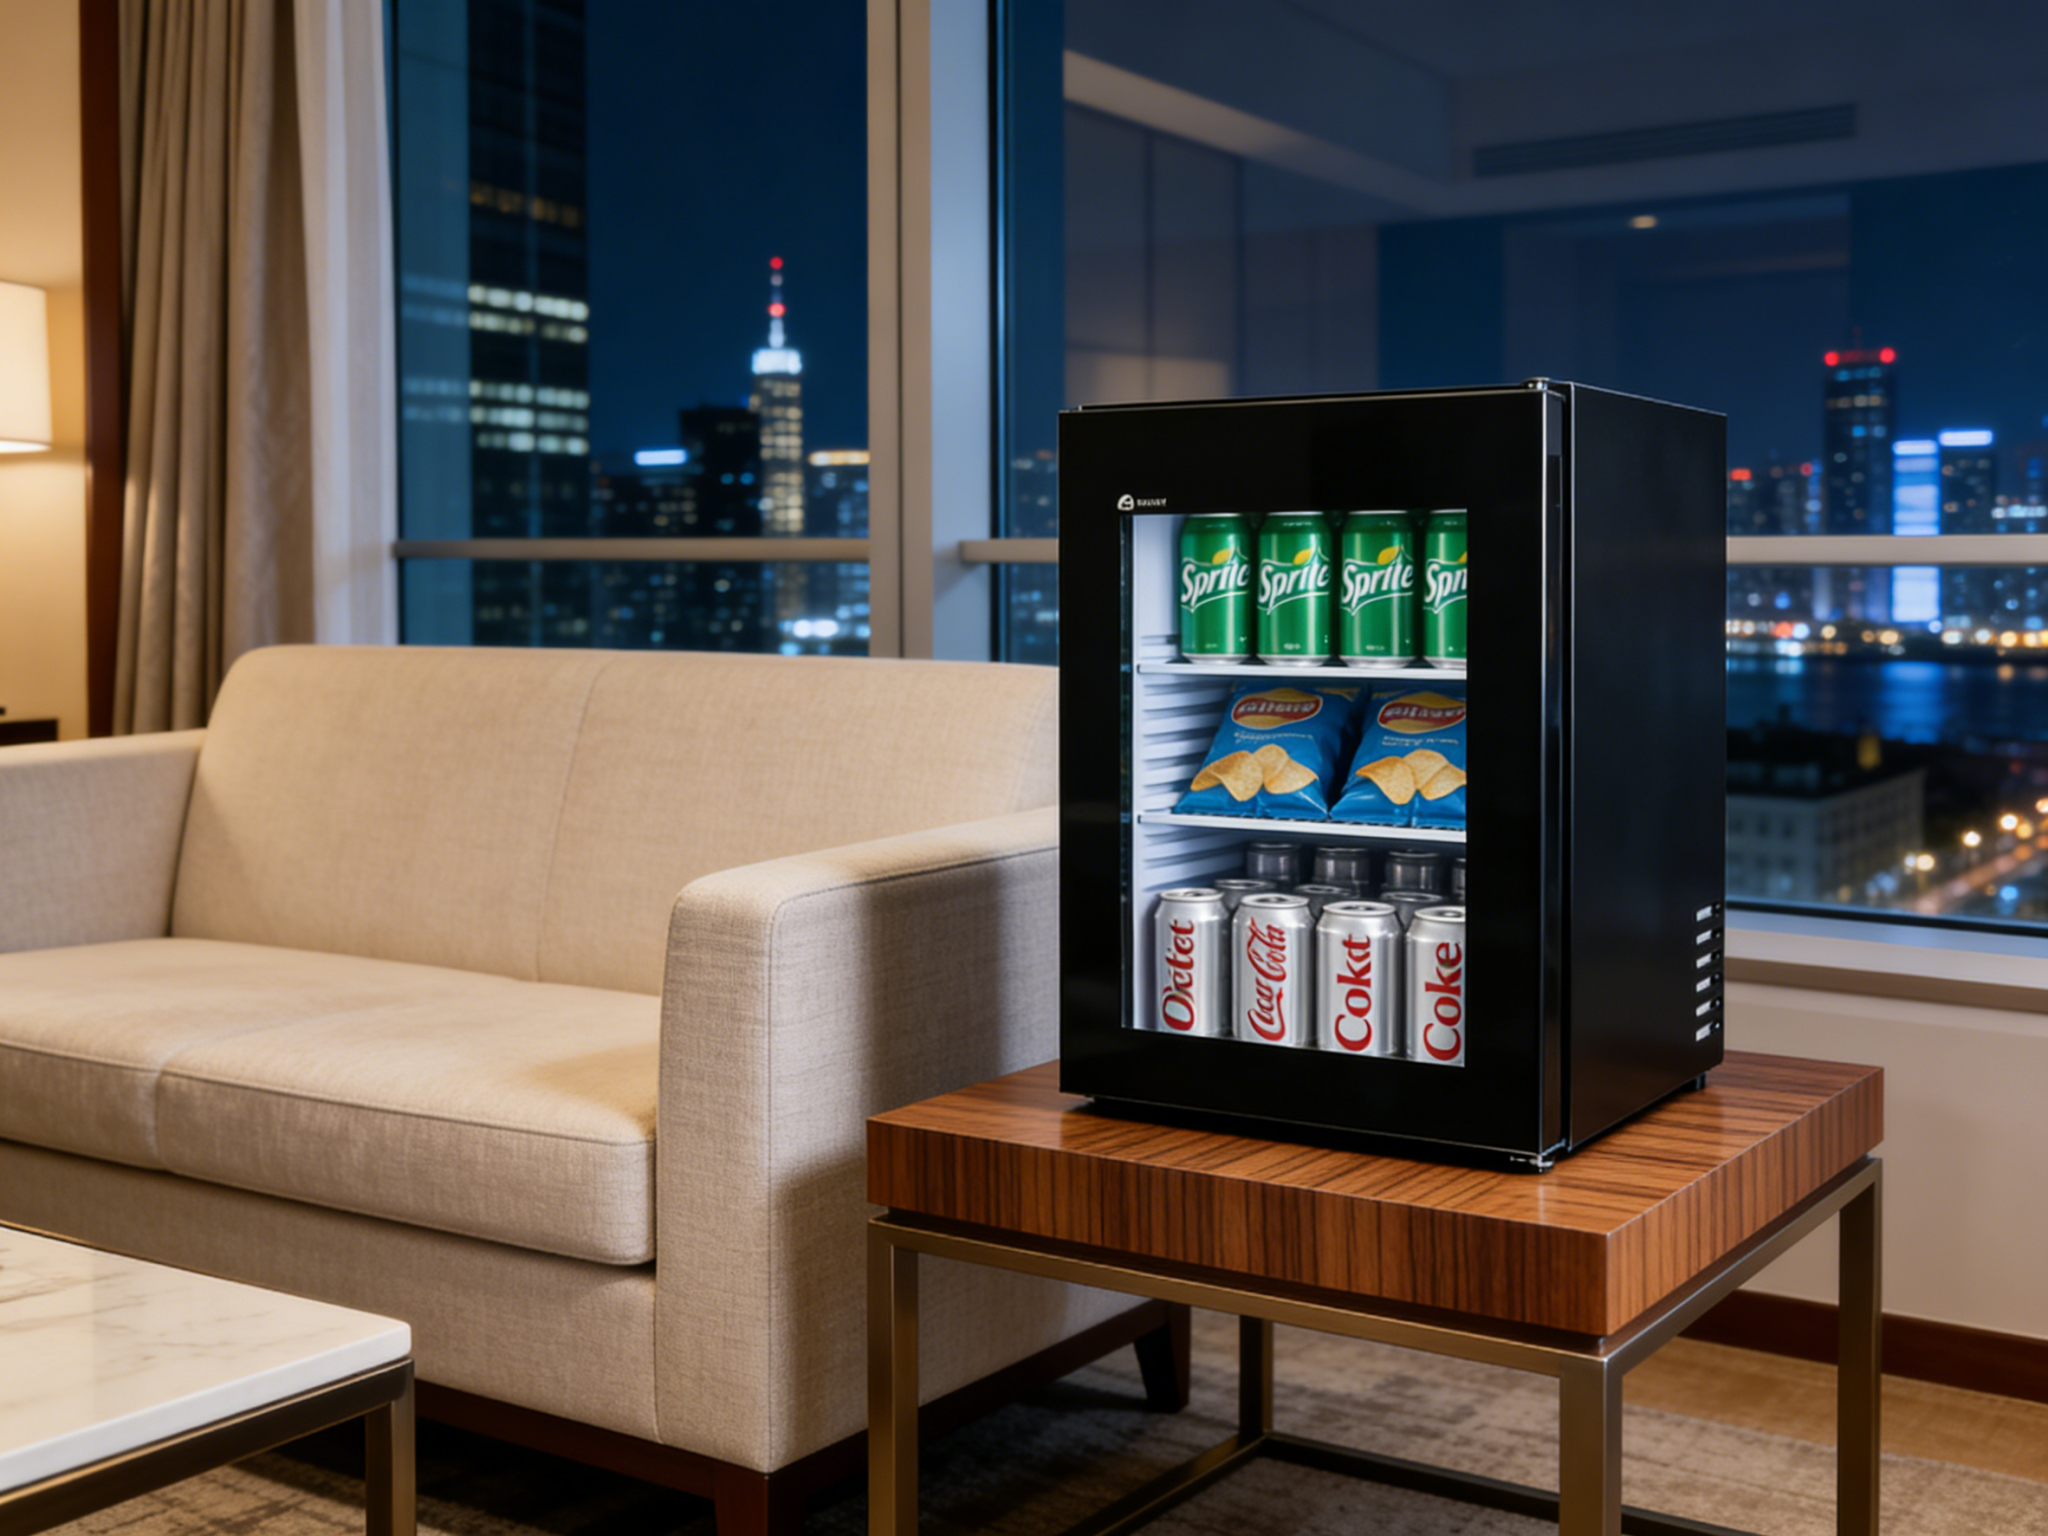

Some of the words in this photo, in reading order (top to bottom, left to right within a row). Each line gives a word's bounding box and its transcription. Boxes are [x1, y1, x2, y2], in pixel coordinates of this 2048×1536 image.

[1180, 556, 1249, 607] Sprite
[1258, 556, 1329, 614] Sprite
[1341, 554, 1413, 609] Sprite
[1423, 942, 1463, 1062] Coke
